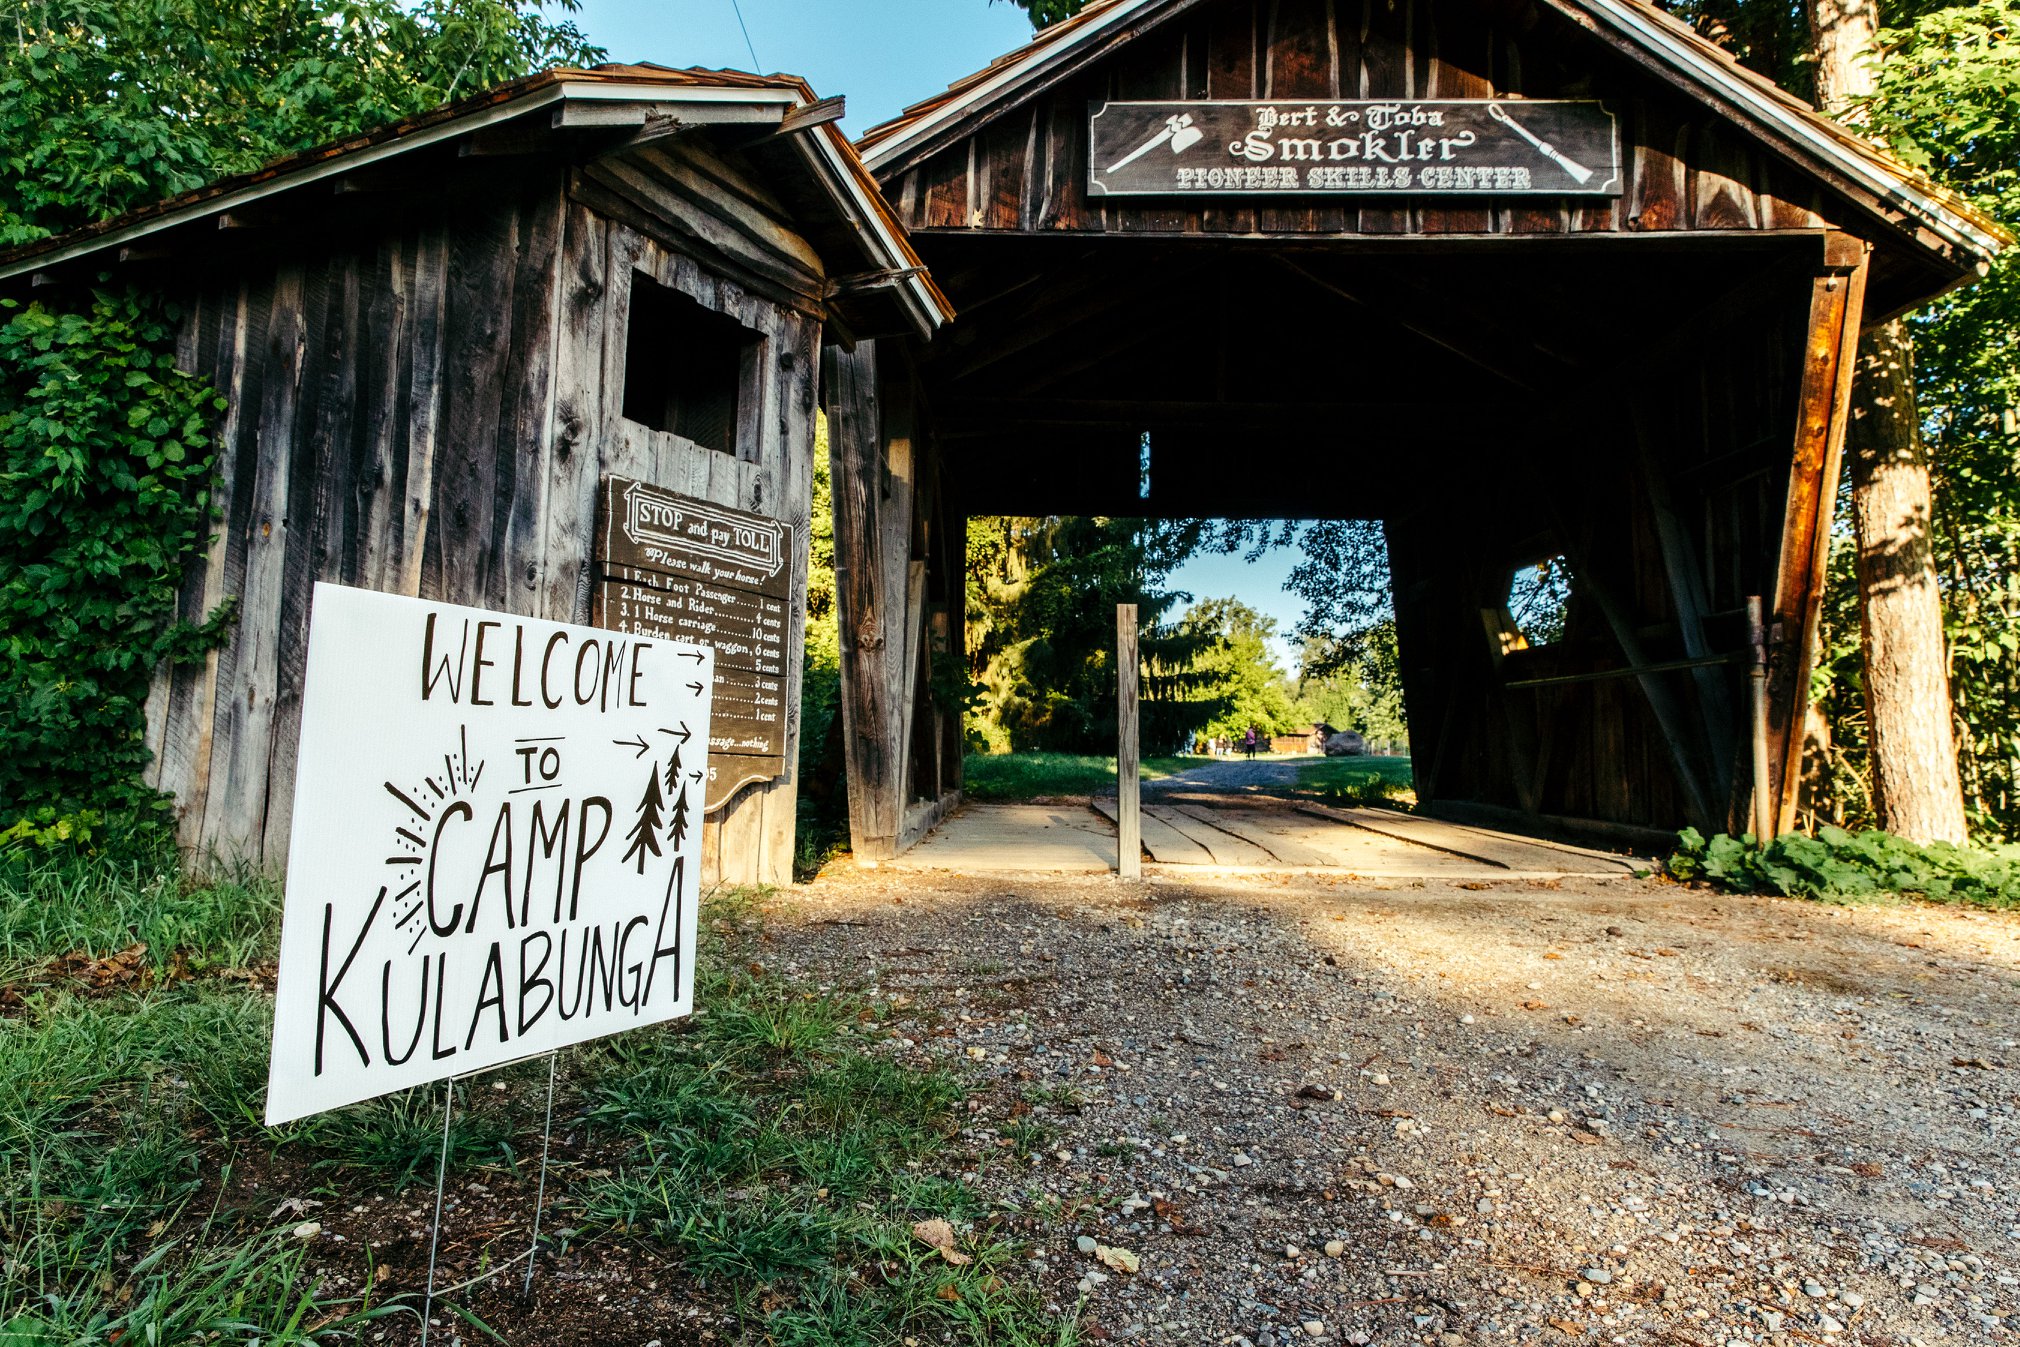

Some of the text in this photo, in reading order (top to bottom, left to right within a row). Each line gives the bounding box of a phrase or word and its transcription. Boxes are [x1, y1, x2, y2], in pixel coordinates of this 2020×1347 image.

[1256, 104, 1445, 130] Bert & Toba
[1229, 126, 1476, 163] Smokler
[1176, 166, 1532, 190] PIONEER SKILLS CENTER
[640, 503, 769, 553] STOP and pay TOLL
[645, 547, 766, 586] Please walk your horse!
[620, 586, 781, 628] 2. Horse and Rider 4 cents
[666, 577, 689, 593] Foot
[695, 583, 736, 604] Passenger
[760, 598, 764, 609] 1
[766, 602, 781, 613] cent
[620, 602, 780, 644] 3. 1 Horse carriage 10 cents
[634, 621, 670, 640] Burden
[676, 634, 694, 644] cart
[699, 639, 709, 647] or
[714, 640, 752, 656] waggon,
[755, 644, 762, 656] 6
[763, 649, 780, 659] cents
[422, 612, 654, 713] WELCOME
[755, 659, 780, 673] 5 cents
[754, 692, 778, 706] 2 cents
[755, 676, 761, 688] 3
[761, 681, 778, 691] cents
[755, 708, 777, 722] 1 cent
[741, 736, 769, 752] nothing
[516, 746, 561, 784] TO
[427, 795, 613, 938] CAMP
[314, 856, 685, 1077] KULABUNGA
